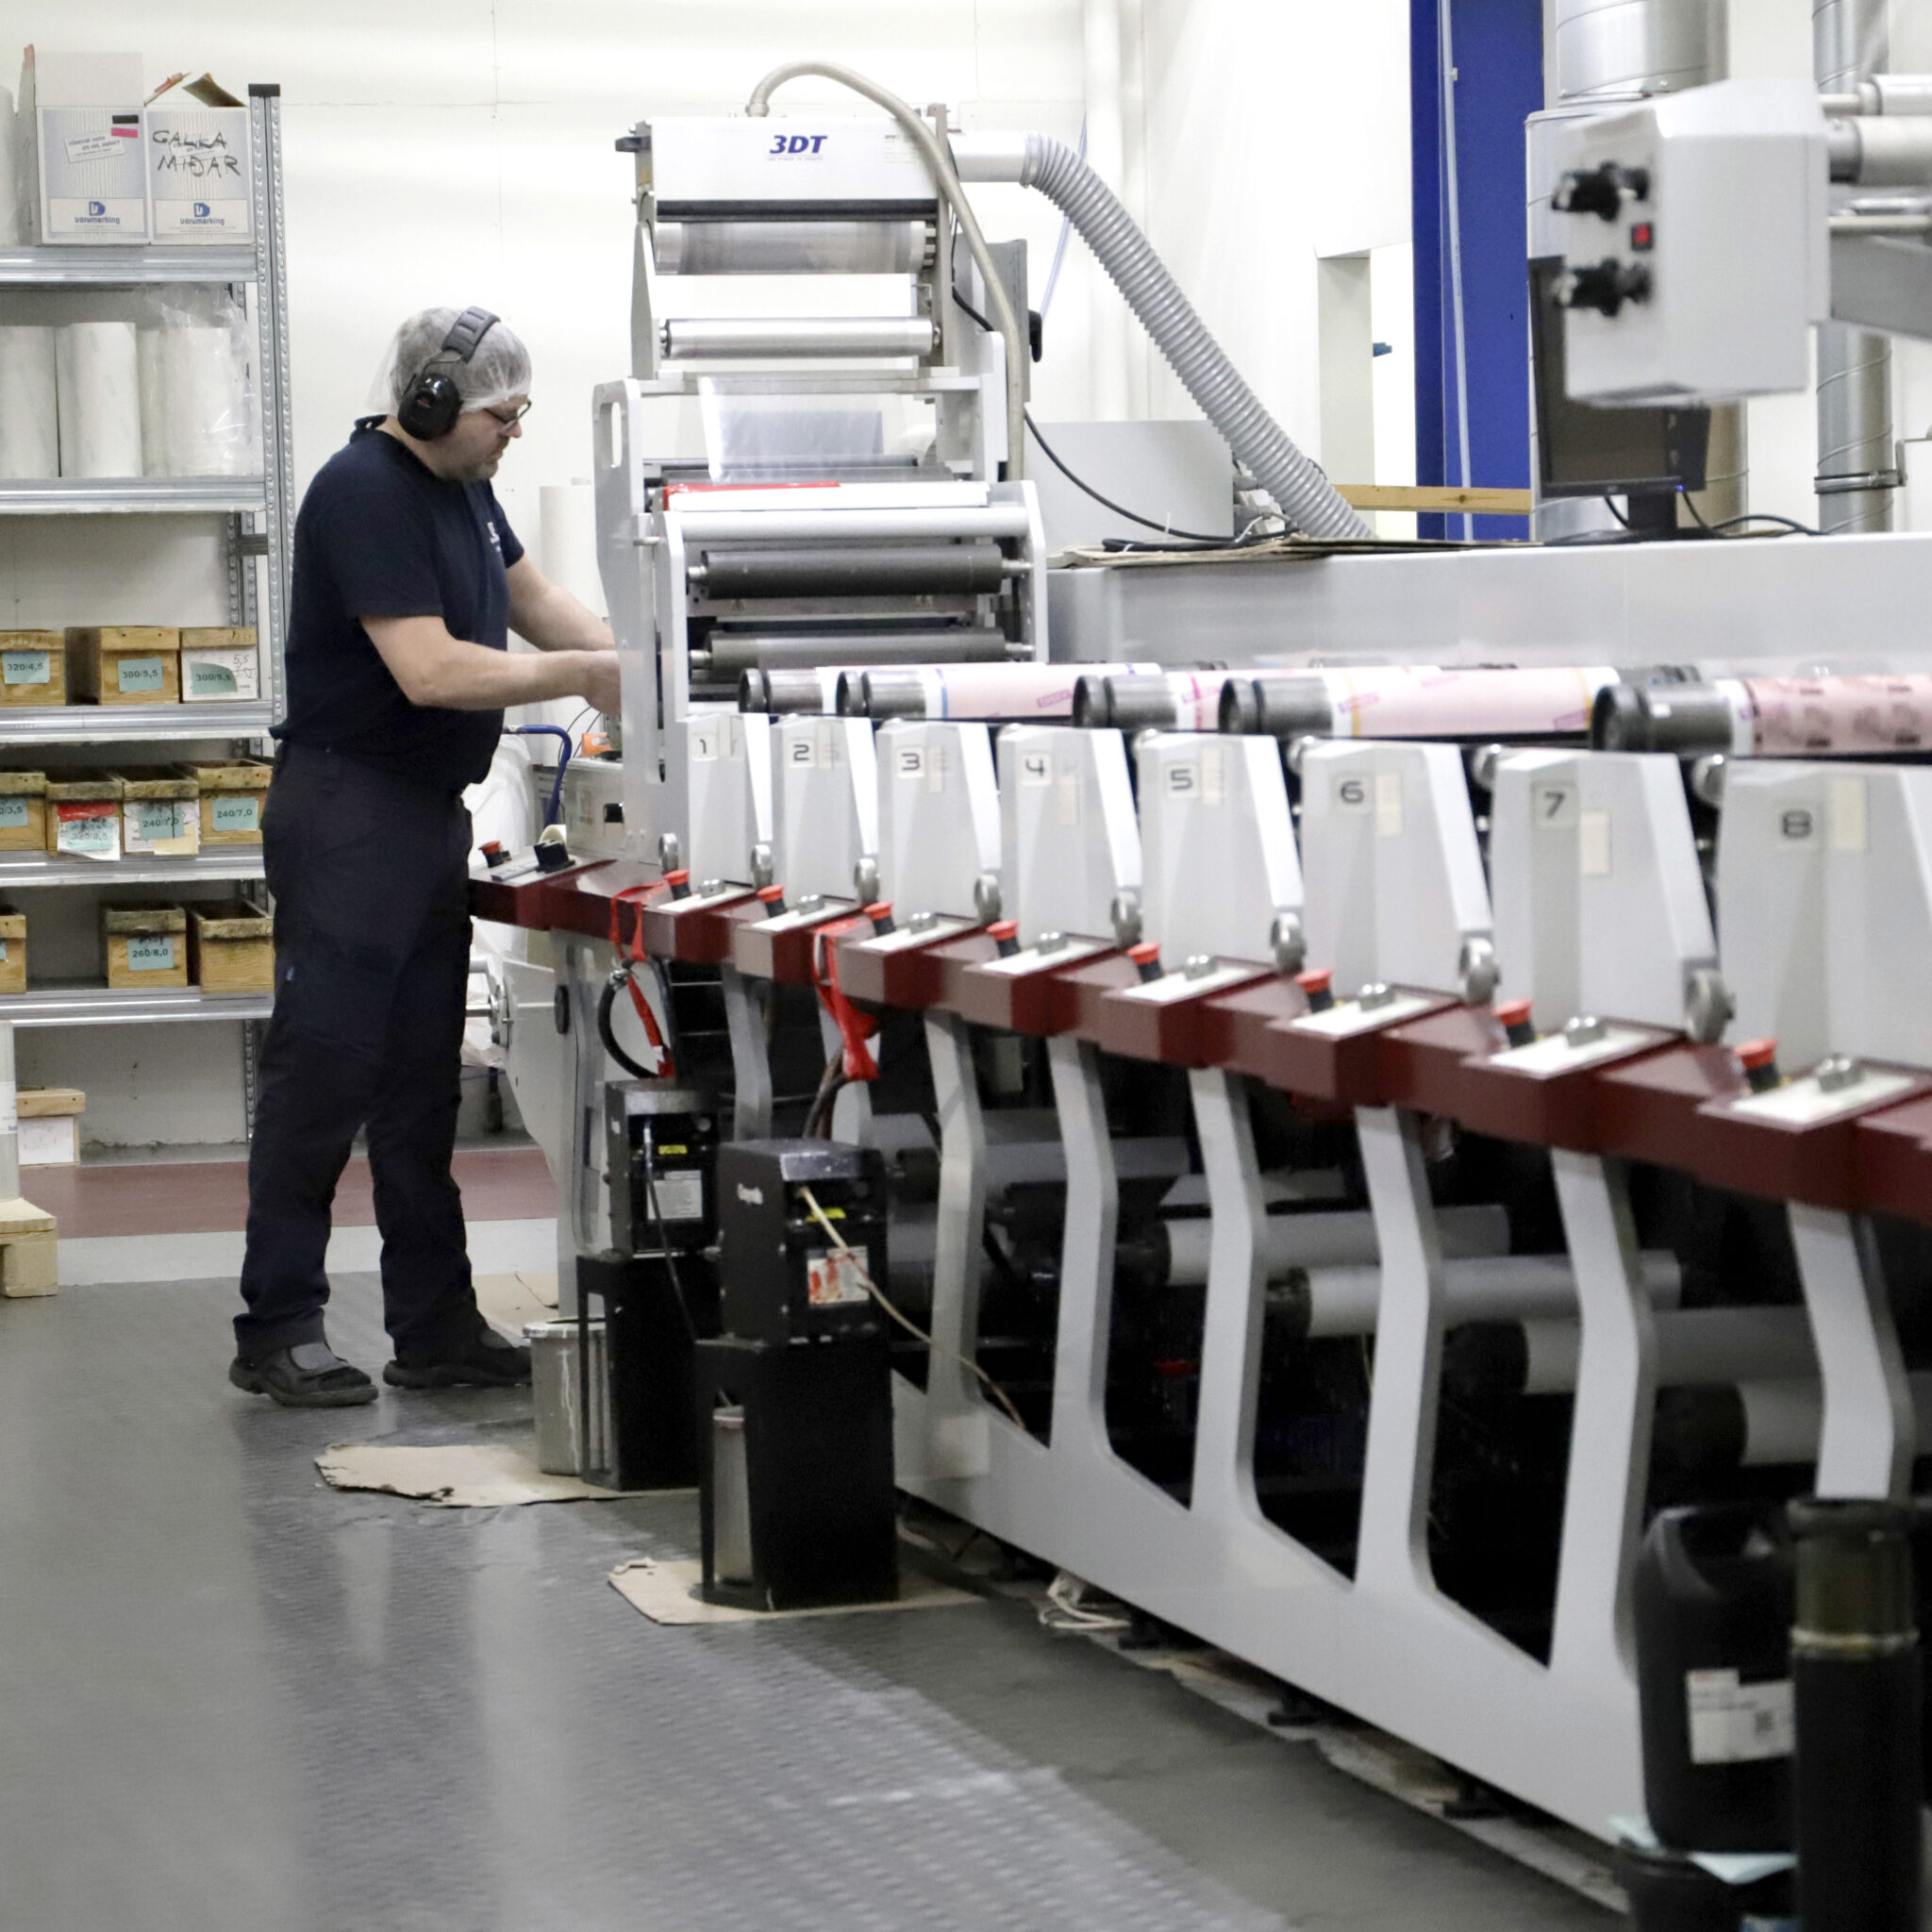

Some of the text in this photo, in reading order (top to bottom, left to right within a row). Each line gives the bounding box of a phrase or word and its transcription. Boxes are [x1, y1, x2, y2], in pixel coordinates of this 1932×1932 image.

[152, 130, 228, 149] GALLA
[770, 135, 828, 154] 3DT
[8, 661, 44, 673] 320/4,5
[122, 668, 158, 679] 300/5,5
[699, 738, 708, 755] 1
[792, 743, 810, 761] 2
[901, 752, 921, 771] 3
[1024, 758, 1045, 777] 4
[1171, 768, 1193, 791] 5
[1340, 780, 1364, 803] 6
[216, 808, 253, 819] 240/7,0
[1544, 791, 1566, 818] 7
[1782, 809, 1813, 839] 8
[132, 948, 169, 958] 260/8,0
